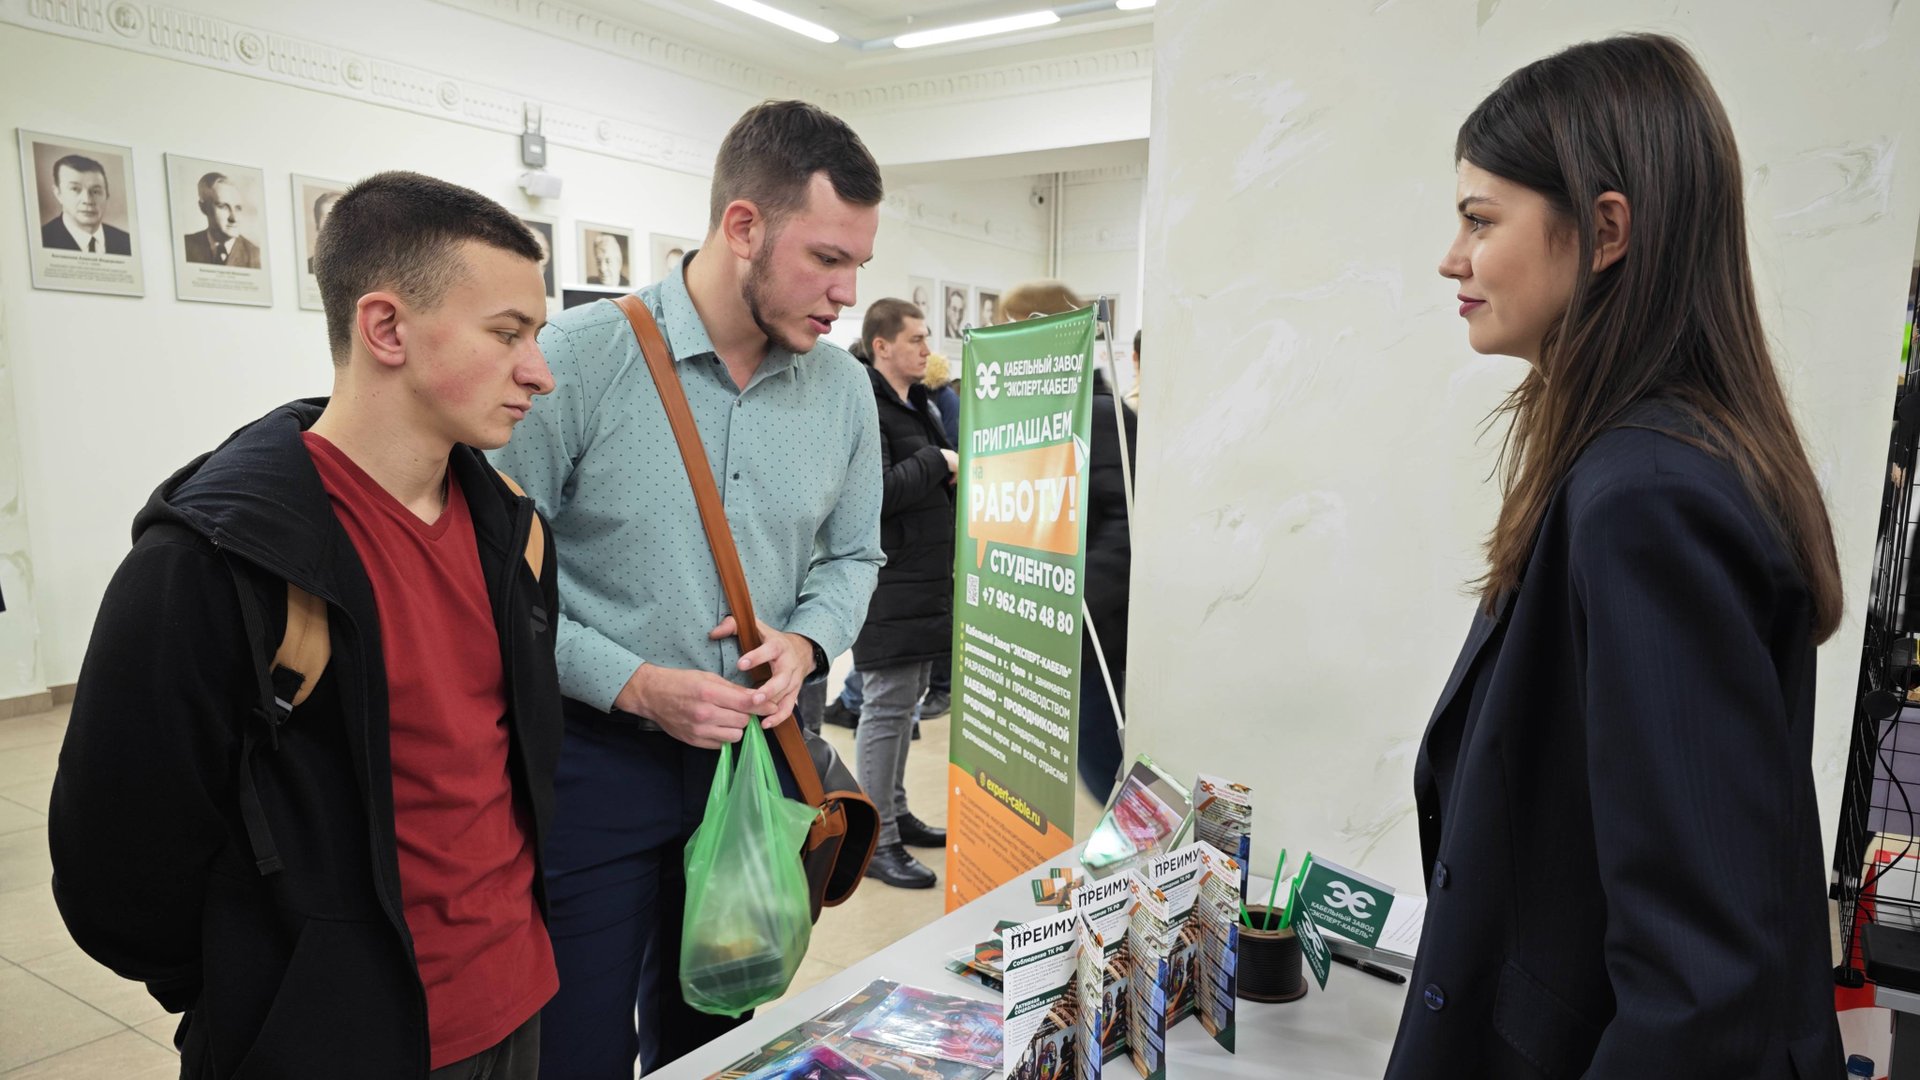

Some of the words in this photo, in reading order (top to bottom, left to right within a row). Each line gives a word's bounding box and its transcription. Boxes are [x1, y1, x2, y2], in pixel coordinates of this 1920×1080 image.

[1003, 355, 1052, 377] КАБЕЛЬНЫЙ
[1053, 354, 1084, 374] ЗАВОД
[1004, 376, 1082, 397] "ЭКСПЕРТ-КАБЕЛЬ"
[973, 410, 1073, 454] ПРИГЛАШАЕМ
[971, 475, 1077, 523] РАБОТУ!
[990, 548, 1076, 595] СТУДЕНТОВ
[982, 586, 995, 605] +7
[996, 590, 1016, 614] 962
[1017, 598, 1037, 622] 475
[1039, 605, 1055, 629] 48
[1057, 610, 1074, 635] 80
[964, 656, 1004, 686] РАЗРАБОТКОЙ
[1012, 681, 1071, 720] ПРОИЗВОДСТВОМ
[1003, 696, 1070, 744] ПРОВОДНИКОВОЙ
[986, 779, 1040, 827] expert-cable.ru
[1155, 848, 1200, 878] ПРЕИМУ
[1078, 877, 1130, 908] ПРЕИМУ
[1011, 914, 1078, 950] ПРЕИМУ
[1311, 901, 1351, 923] КАБЕЛЬНЫЙ
[1352, 919, 1375, 934] ЗАВОД
